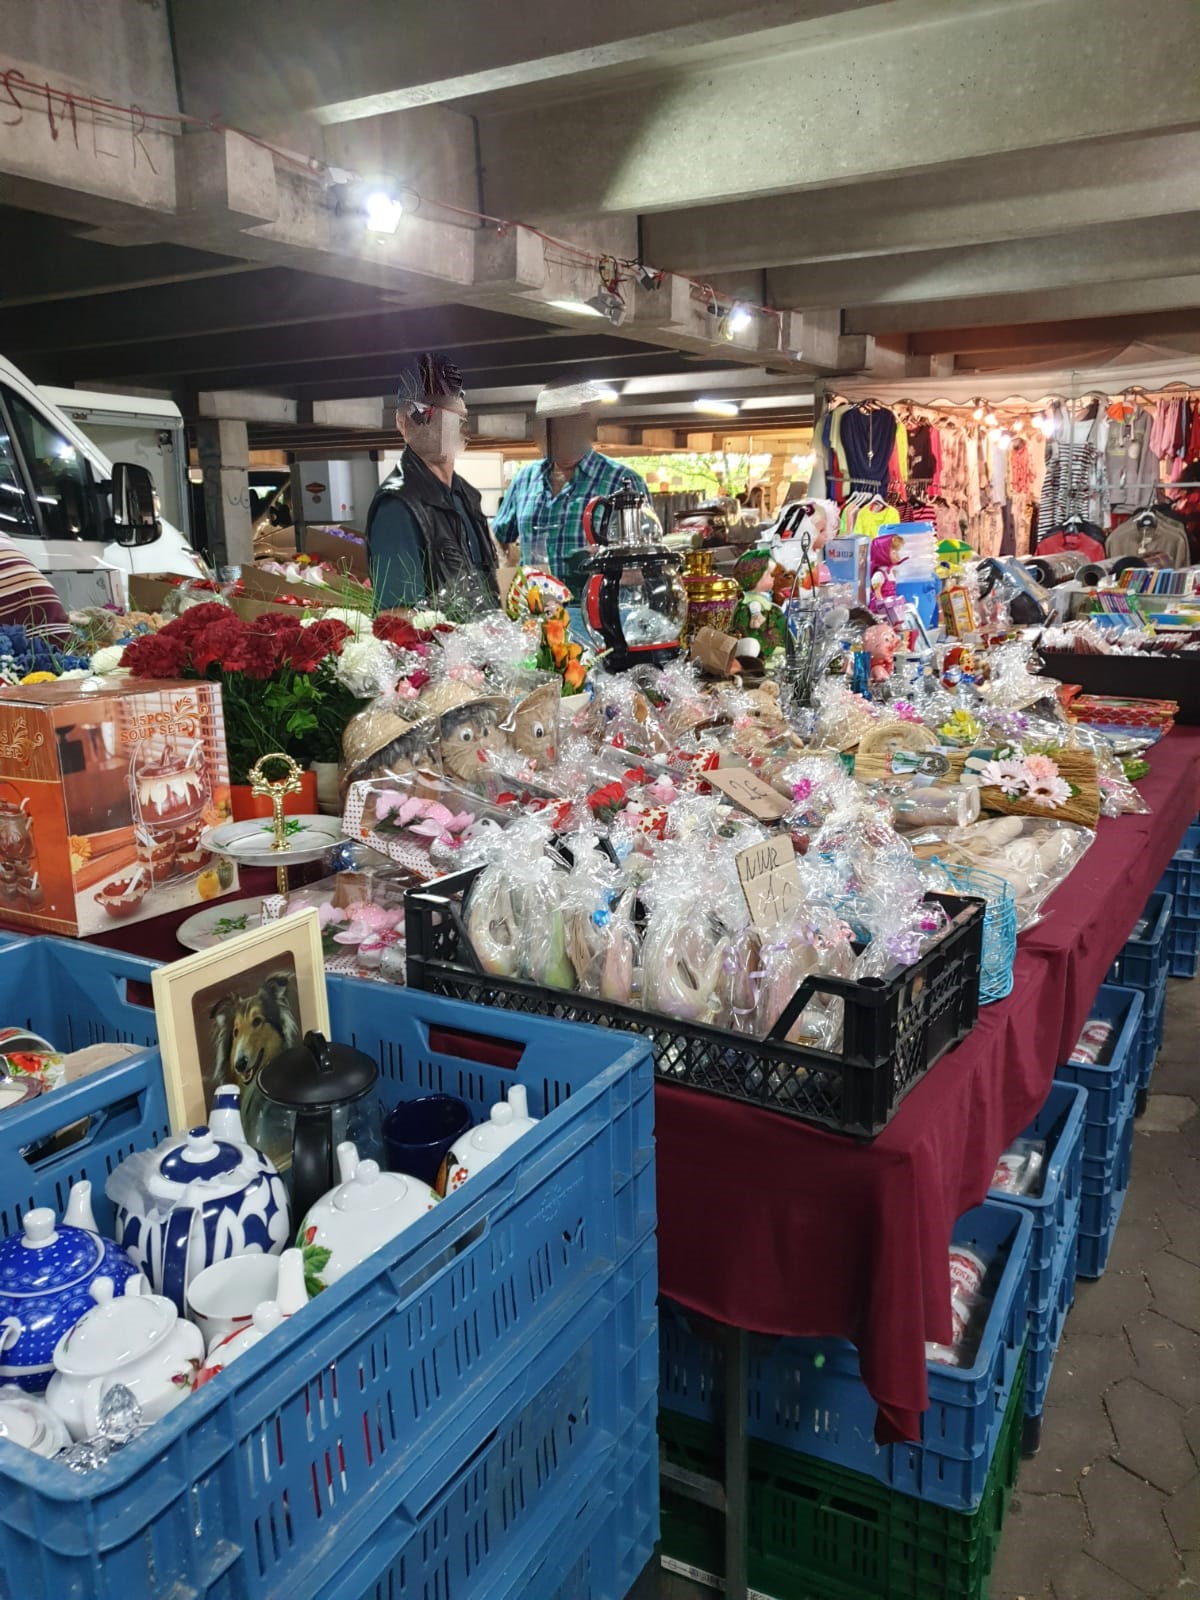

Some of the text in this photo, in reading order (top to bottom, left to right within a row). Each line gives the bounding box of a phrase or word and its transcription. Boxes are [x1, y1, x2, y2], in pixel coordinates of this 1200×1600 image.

[131, 711, 171, 727] 15PCS
[120, 722, 182, 743] SOUP SET
